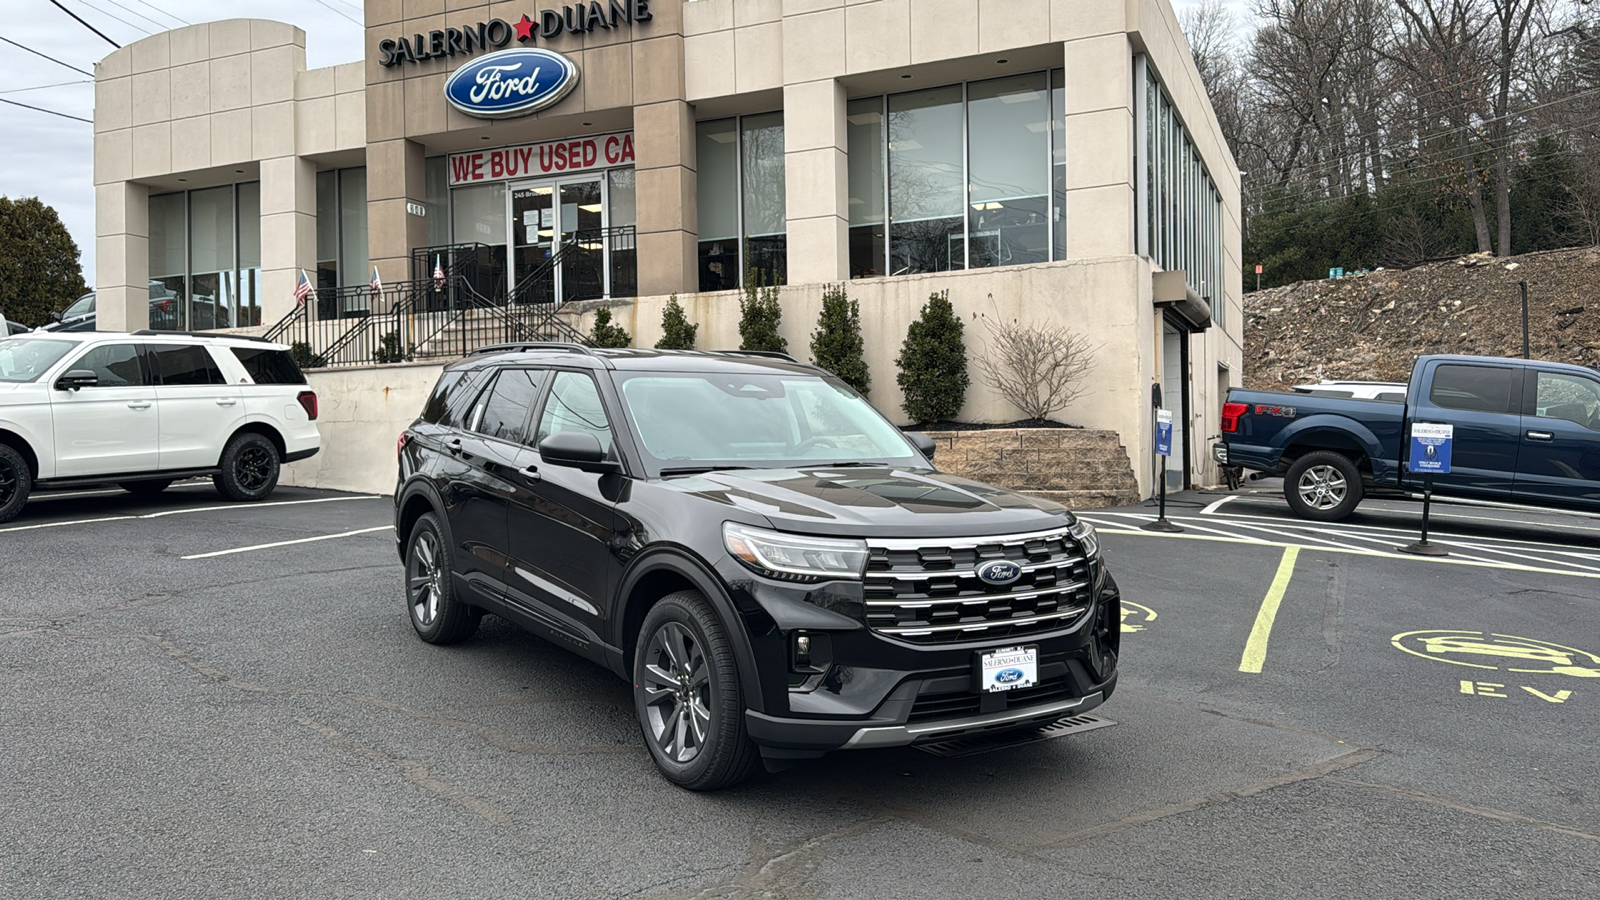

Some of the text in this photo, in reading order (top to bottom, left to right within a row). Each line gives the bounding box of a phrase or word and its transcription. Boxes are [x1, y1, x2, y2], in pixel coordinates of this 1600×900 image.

[379, 0, 653, 67] SALERNO DUANE
[469, 62, 540, 103] Ford
[452, 134, 635, 182] WE BUY USED CA
[1255, 404, 1296, 417] FX4
[990, 565, 1014, 579] Ford
[984, 654, 1035, 667] SALERNO DUANE
[1000, 671, 1018, 682] Ford
[1460, 680, 1572, 703] EV
